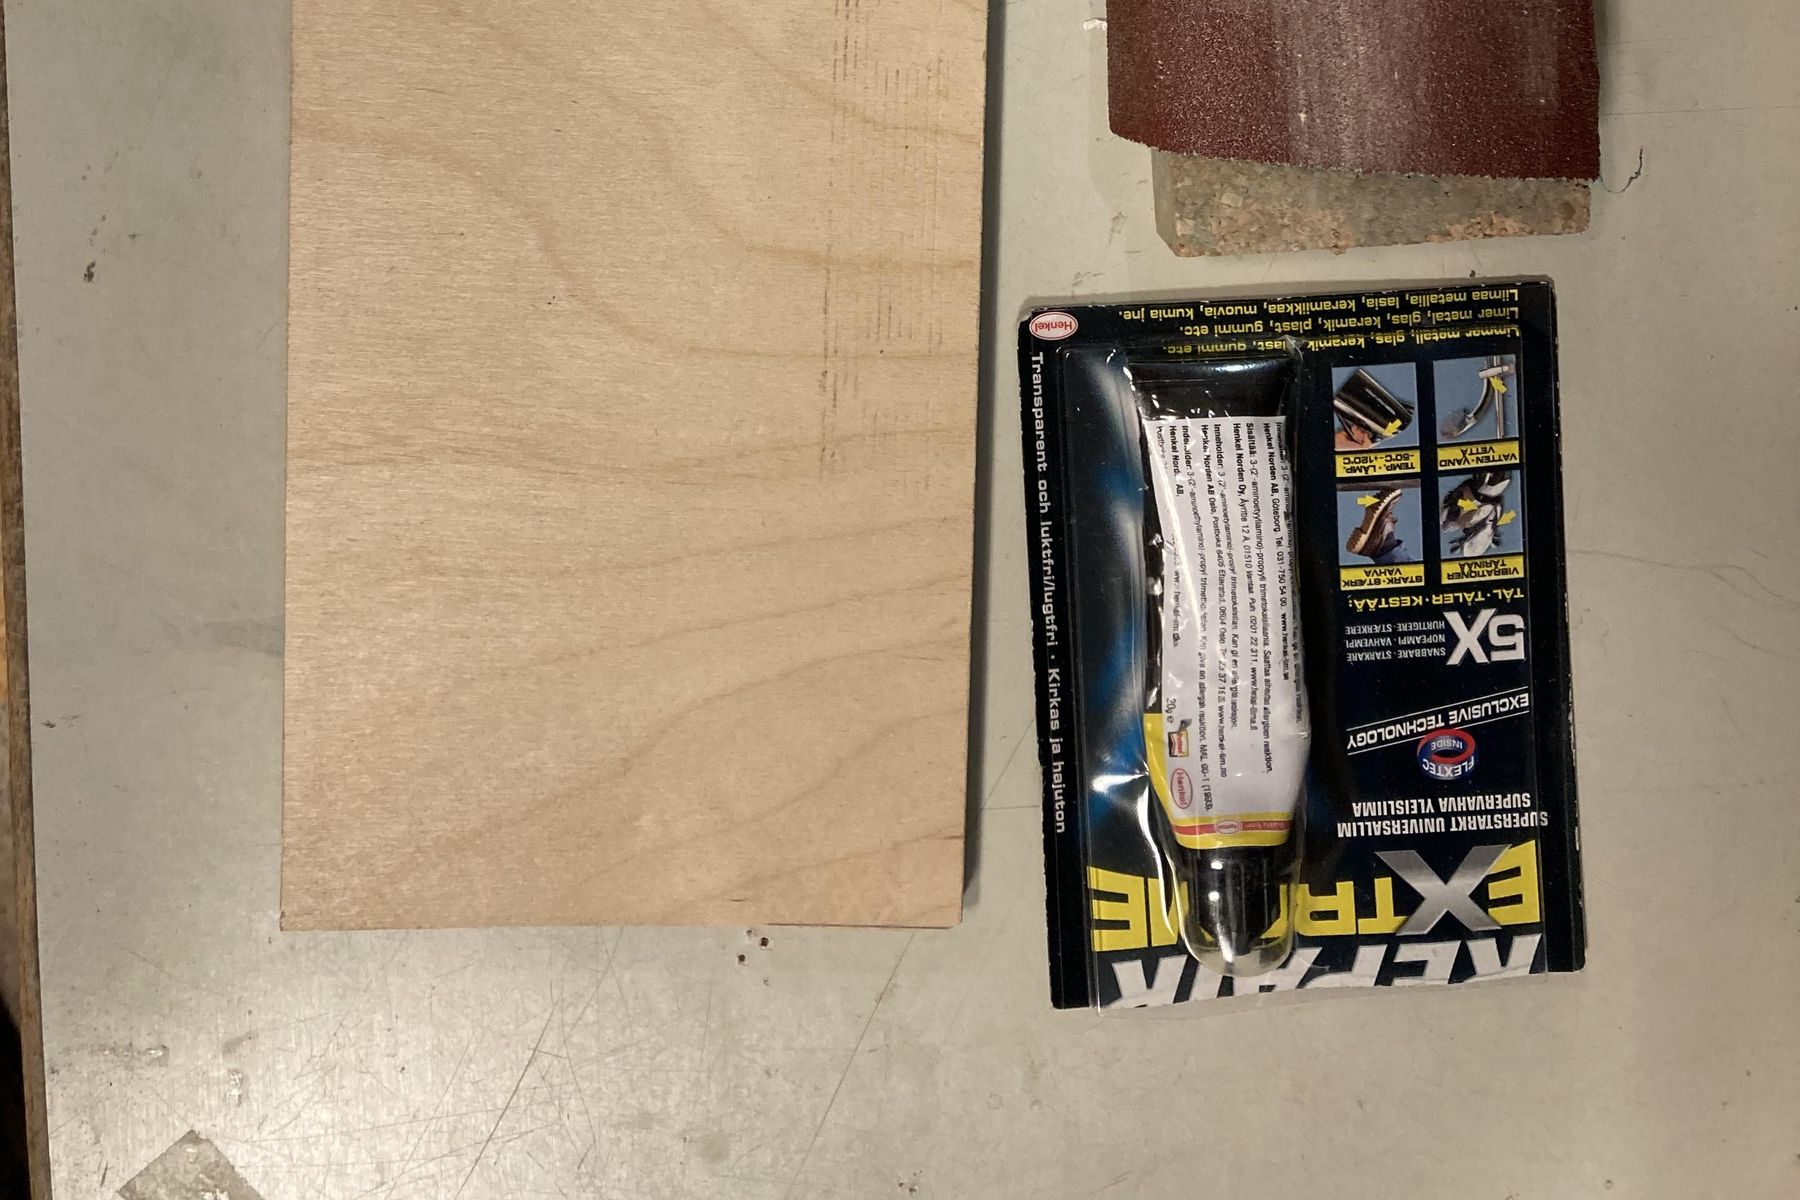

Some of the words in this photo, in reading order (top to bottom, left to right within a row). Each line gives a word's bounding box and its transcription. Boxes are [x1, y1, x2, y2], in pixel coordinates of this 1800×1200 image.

[1361, 295, 1400, 309] lasia,
[1405, 291, 1467, 307] metallia,
[1472, 288, 1519, 302] Liimaa
[1150, 308, 1195, 321] kumia
[1200, 303, 1258, 317] muovia,
[1263, 299, 1357, 315] keramiikkaa,
[1477, 307, 1519, 322] Limer
[1118, 309, 1146, 323] jne.
[1318, 316, 1382, 332] keramik,
[1386, 311, 1422, 326] glas,
[1427, 308, 1473, 325] metal,
[1034, 320, 1074, 332] Henkel
[1180, 325, 1209, 338] etc.
[1214, 321, 1264, 336] gummi
[1271, 319, 1313, 334] plast,
[1031, 351, 1049, 472] Transparent
[1169, 425, 1179, 453] Henkel
[1233, 423, 1243, 451] Henkel
[1263, 423, 1274, 450] Henkel
[1213, 424, 1225, 469] Inneholder:
[1203, 455, 1214, 482] Norden
[1236, 453, 1246, 482] Norden
[1268, 452, 1277, 481] Norden
[1037, 479, 1051, 513] och
[1206, 484, 1215, 495] AB
[1237, 484, 1247, 497] Oy,
[1270, 482, 1279, 497] AB,
[1241, 525, 1250, 534] 12
[1243, 545, 1253, 569] 01510
[1277, 552, 1287, 584] 031-750
[1363, 567, 1402, 577] VAHVA
[1446, 566, 1520, 581] VIBRATIONER
[1040, 521, 1058, 646] luktfri/lugtfri
[1280, 585, 1288, 596] 54
[1249, 615, 1258, 634] 0201
[1396, 620, 1446, 632] HURTIGERE
[1250, 636, 1258, 646] 22
[1345, 637, 1392, 649] VAHVEMPI
[1398, 633, 1446, 645] NOPEAMPI
[1442, 607, 1527, 666] 5X
[1397, 647, 1446, 659] SNABBARE
[1218, 673, 1227, 683] 37
[1047, 667, 1062, 730] Kirkas
[1448, 692, 1529, 725] EXCLUSIVE
[1346, 715, 1445, 750] TECHNOLOGY
[1049, 738, 1064, 754] ja
[1429, 739, 1463, 751] INSIDE
[1421, 756, 1475, 778] FLEXTEC
[1052, 761, 1067, 833] hajuton
[1176, 772, 1188, 806] Henkel
[1351, 797, 1435, 818] YLEISLIIMA
[1438, 792, 1531, 814] SUPERVAHVA
[1336, 816, 1446, 838] UNIVERSALLIM
[1449, 811, 1549, 832] SUPERSTARKT
